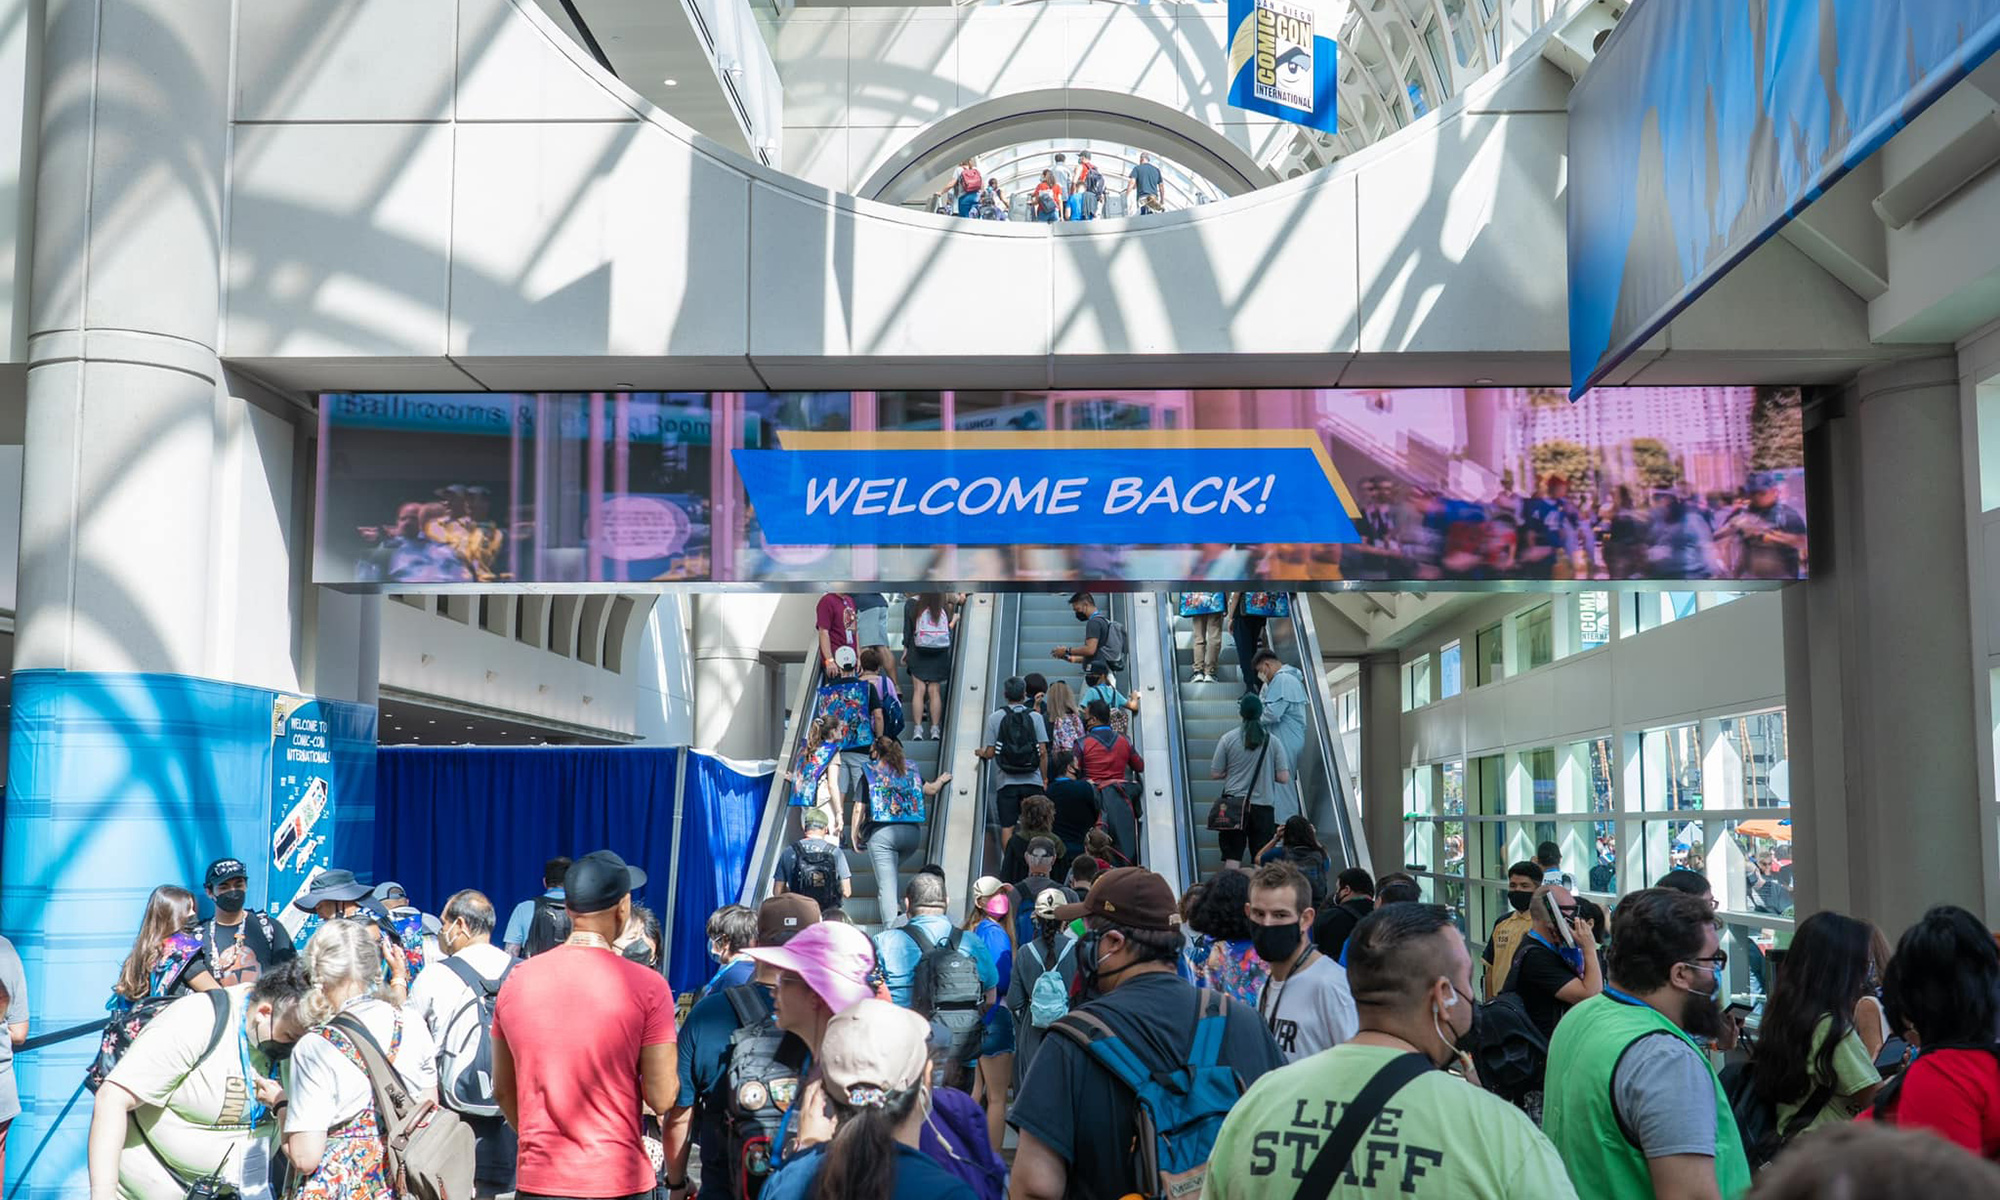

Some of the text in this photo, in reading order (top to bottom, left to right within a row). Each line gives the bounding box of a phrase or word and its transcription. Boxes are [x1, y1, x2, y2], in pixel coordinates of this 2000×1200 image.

[1256, 0, 1312, 22] SAN DIEGO
[1257, 8, 1276, 86] COMIC
[1276, 15, 1312, 50] CON
[1256, 86, 1312, 110] INTERNATIONAL
[805, 474, 1276, 516] WELCOME BACK!
[1580, 591, 1598, 632] COMI
[291, 717, 318, 732] WELCOME
[319, 721, 328, 733] TO
[217, 1077, 246, 1126] OMIC
[1290, 1098, 1403, 1138] LIE
[1250, 1130, 1444, 1194] STFF
